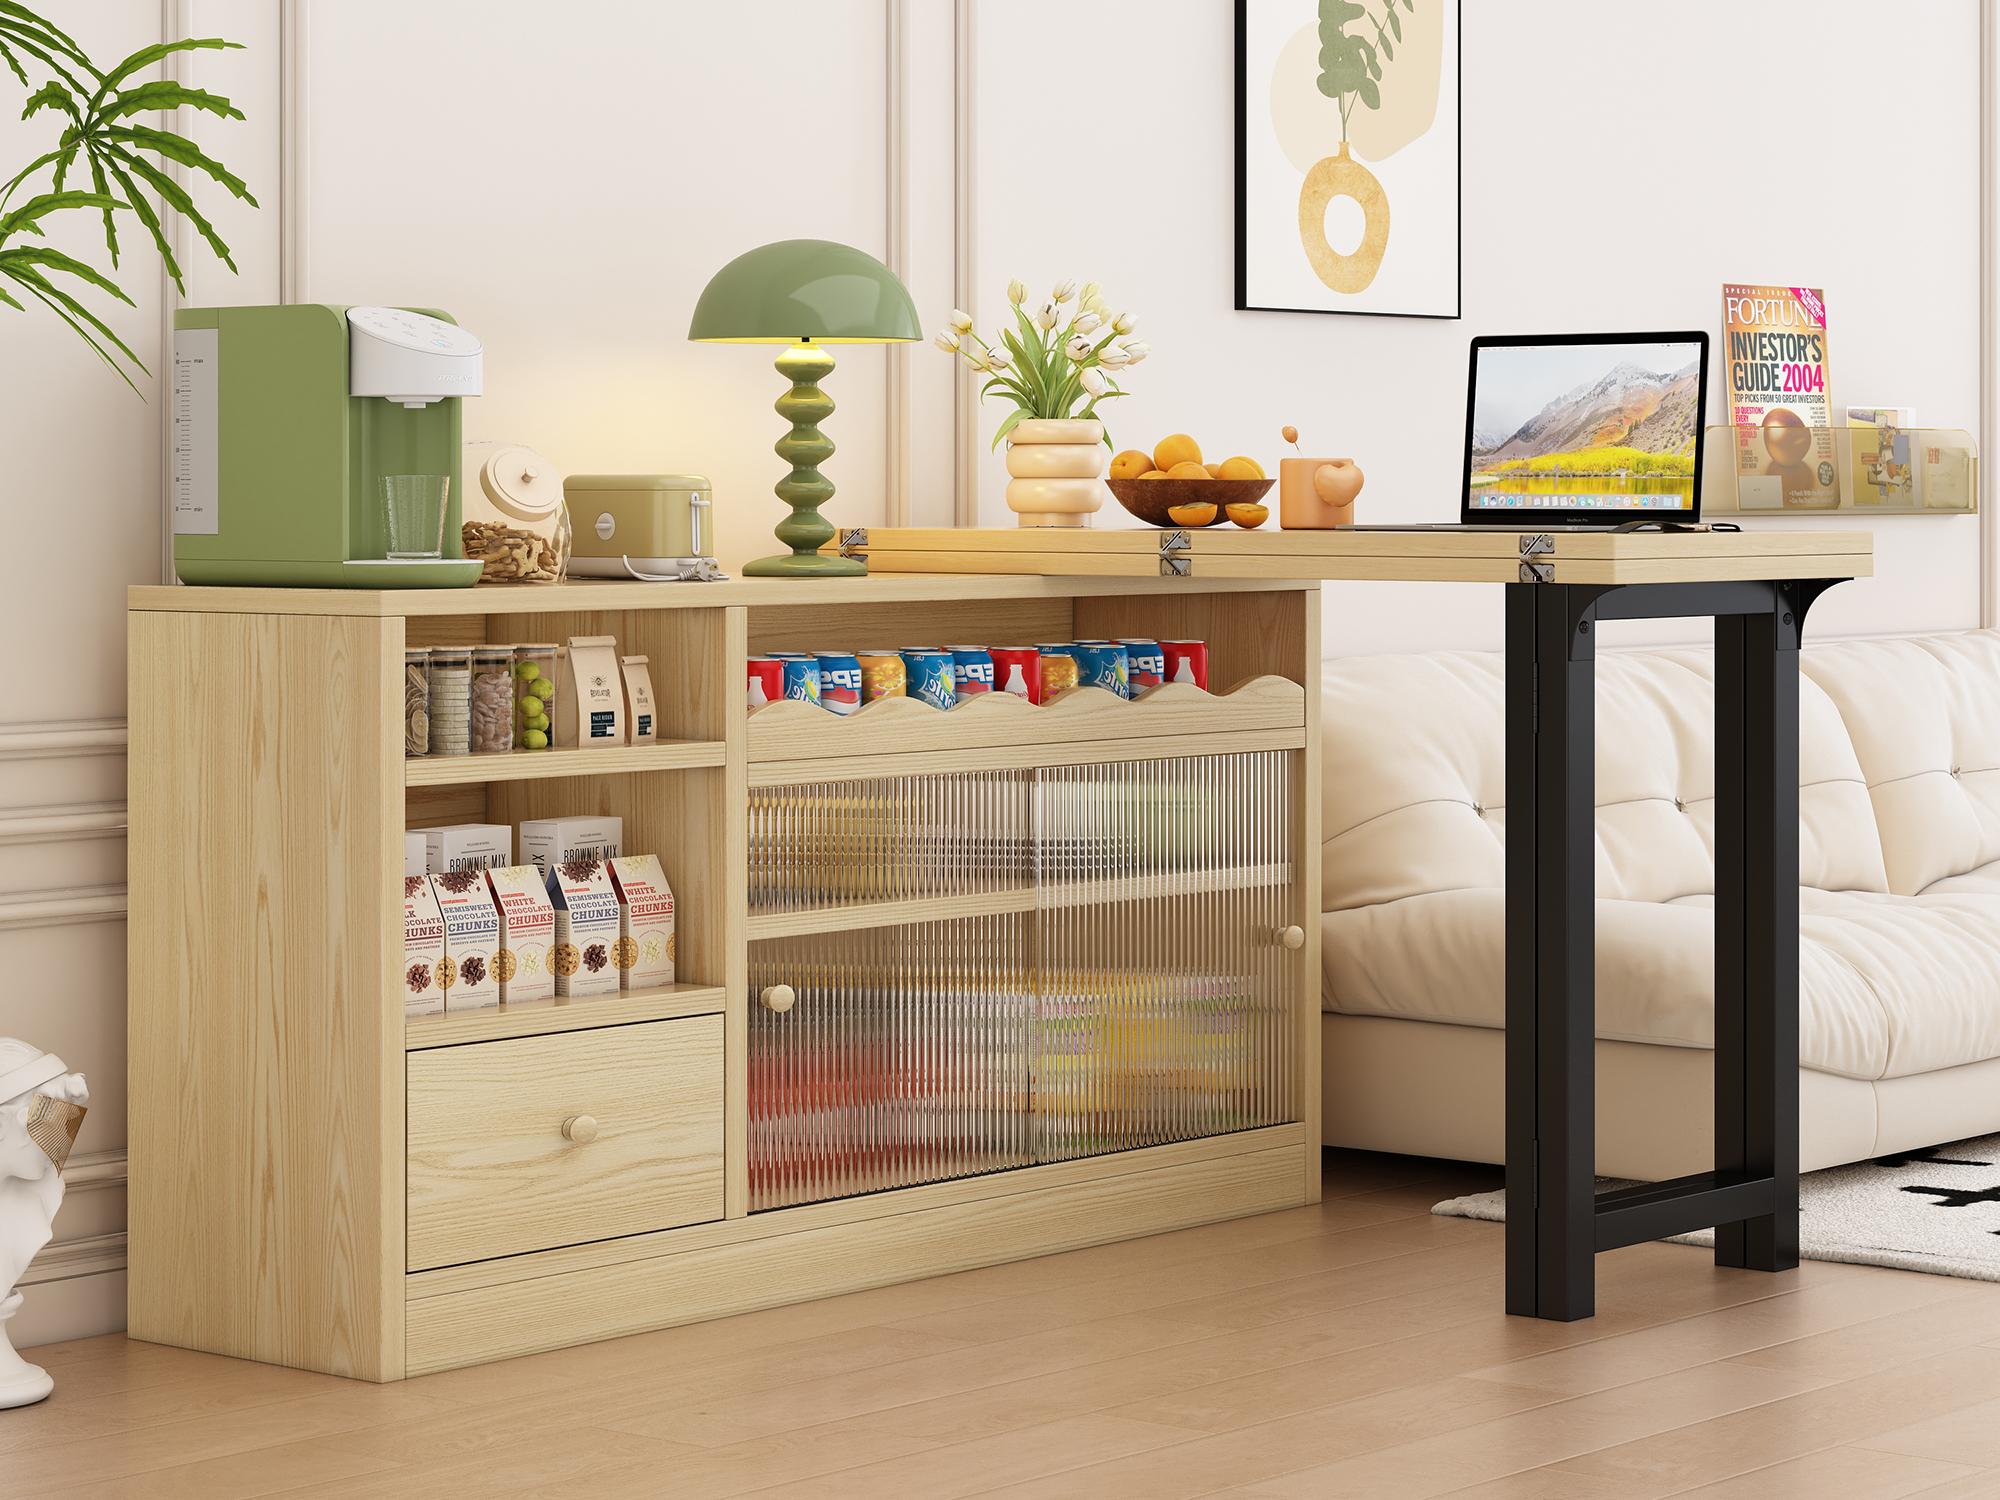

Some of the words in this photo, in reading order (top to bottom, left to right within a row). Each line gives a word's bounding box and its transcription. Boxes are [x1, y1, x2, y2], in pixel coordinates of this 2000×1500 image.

[1725, 287, 1761, 296] SPECIAL
[1766, 289, 1792, 297] ISSUE
[1730, 331, 1822, 363] INVESTOR'S
[1733, 362, 1781, 392] GUIDE
[1782, 363, 1824, 393] 2004
[1734, 393, 1744, 402] TOP
[1745, 393, 1760, 403] PICKS
[1760, 394, 1774, 403] FROM
[1775, 394, 1782, 403] 50
[1782, 394, 1797, 403] GREAT
[1797, 394, 1825, 404] INVESTORS
[1741, 406, 1764, 414] QUESTIONS
[564, 846, 599, 863] BROWNIE
[603, 844, 618, 860] MIX
[449, 855, 488, 873] BROWNIE
[491, 853, 506, 869] MIX
[625, 886, 656, 896] WHITE
[502, 897, 536, 907] WHITE
[567, 892, 614, 902] SEMISWEET
[629, 893, 672, 903] CHOCOLATE
[443, 903, 493, 914] SEMISWEET
[506, 905, 553, 915] CHOCOLATE
[569, 900, 618, 910] CHOCOLATE
[630, 901, 673, 914] CHUNKS
[446, 911, 497, 922] CHOCOLATE
[508, 912, 554, 926] CHUNKS
[571, 908, 619, 920] CHUNKS
[405, 917, 442, 927] OCOLATE
[448, 920, 498, 932] CHUNKS
[405, 926, 443, 938] HUNKS
